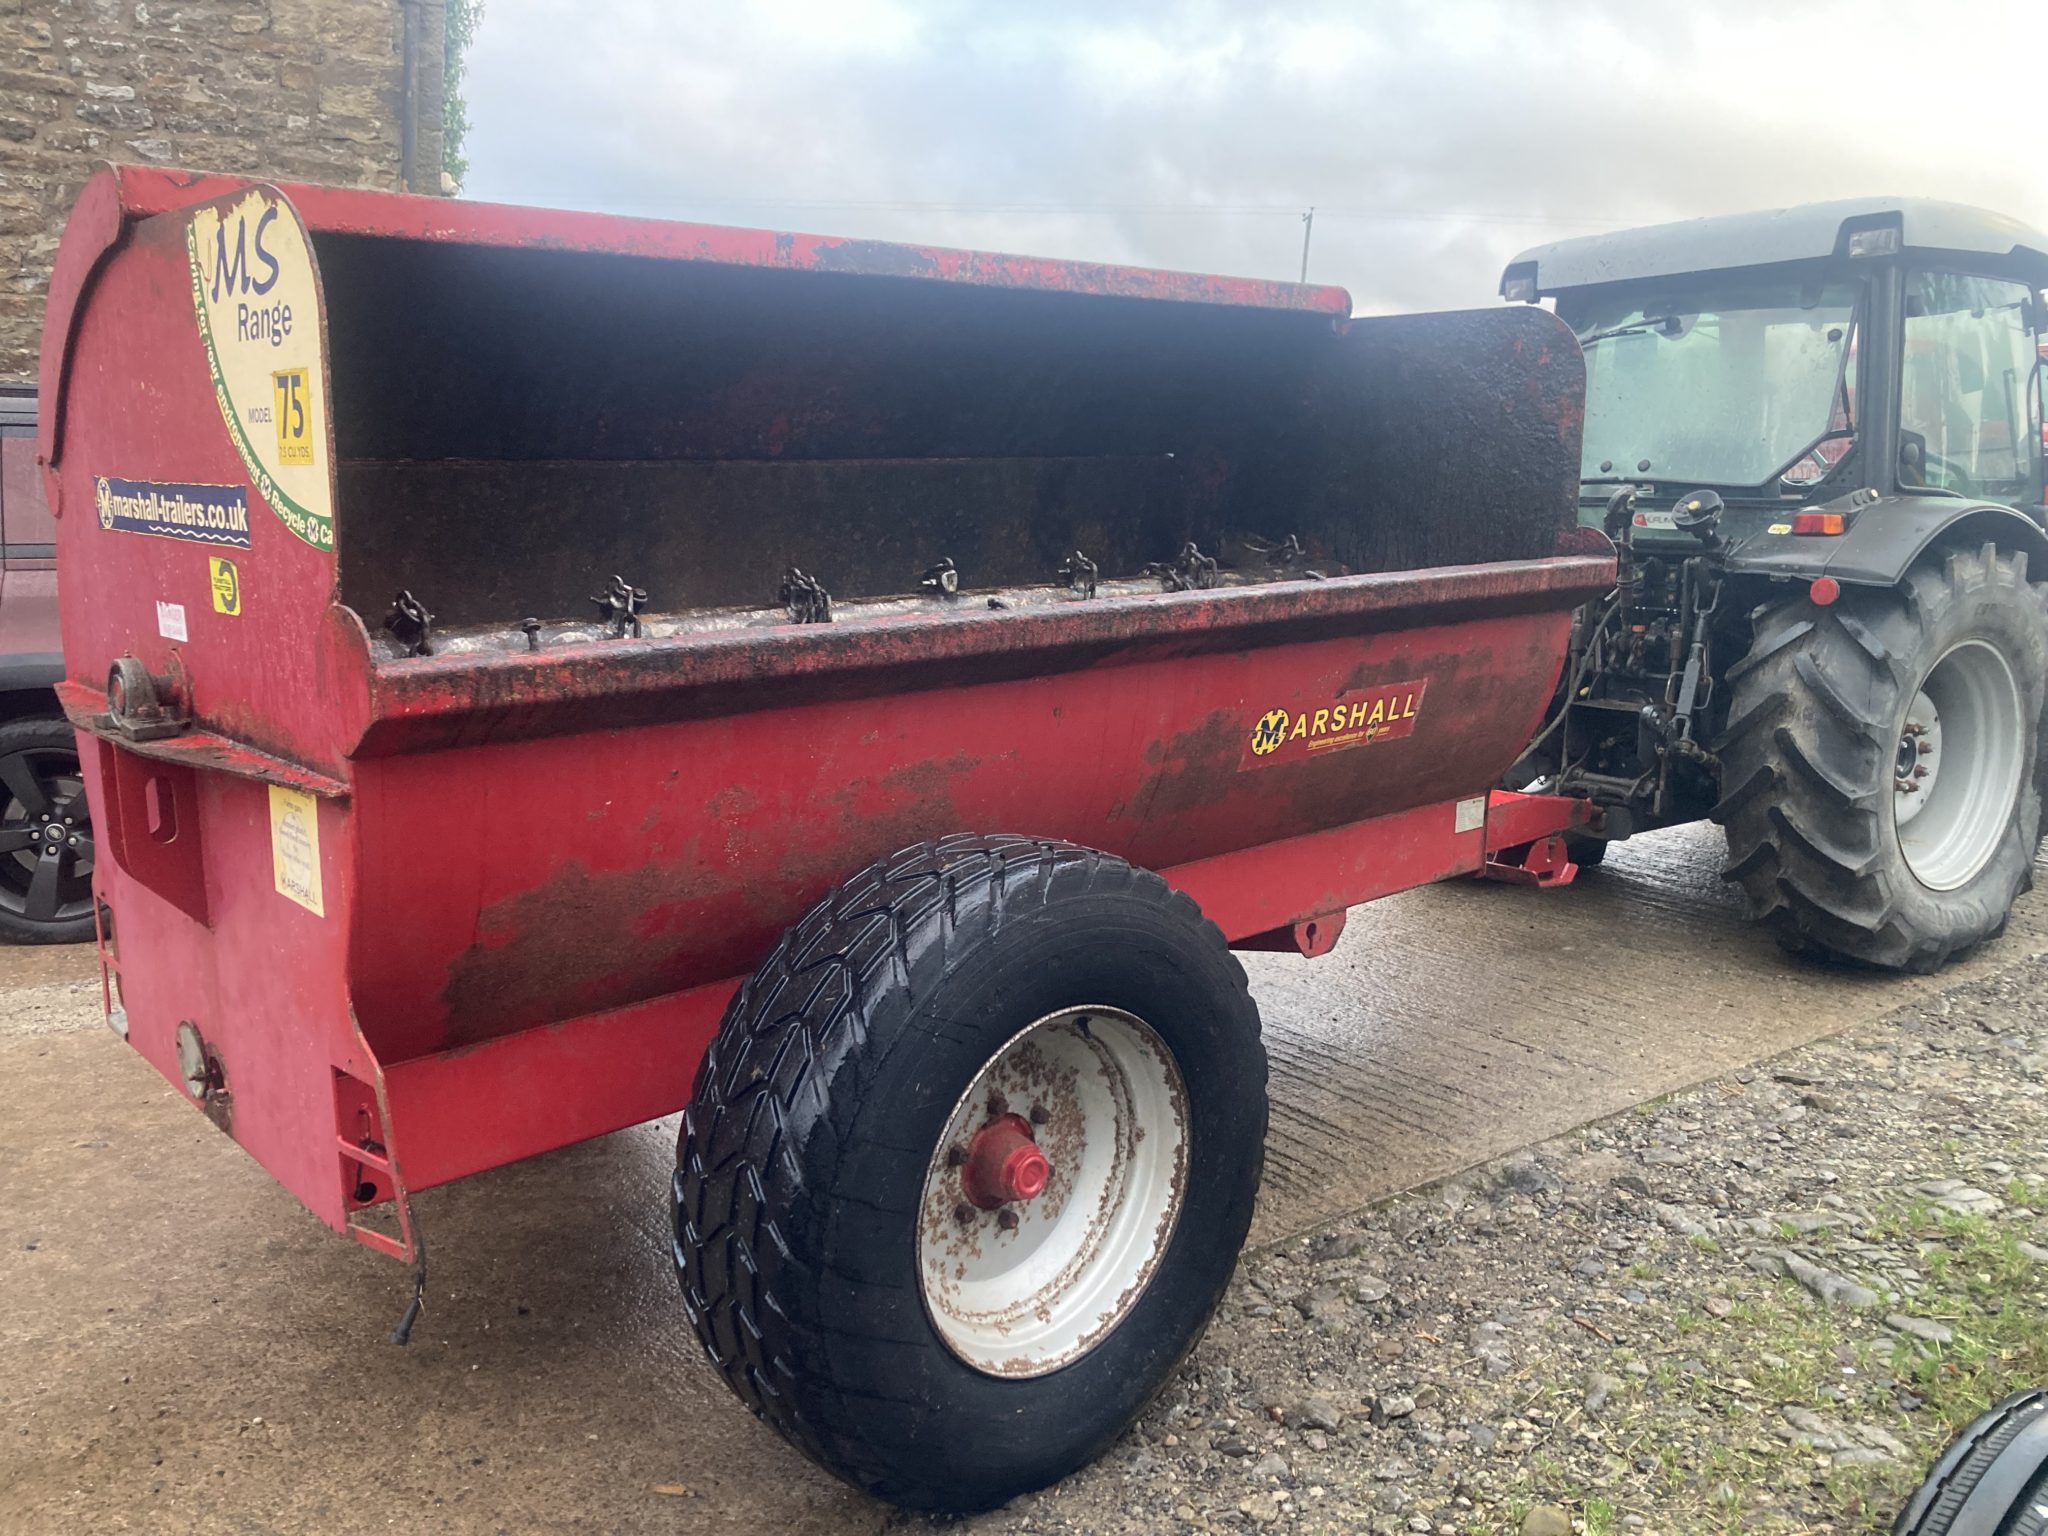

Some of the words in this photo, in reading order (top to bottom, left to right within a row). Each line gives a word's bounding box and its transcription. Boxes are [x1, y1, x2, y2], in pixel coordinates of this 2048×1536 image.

[212, 206, 280, 304] MS
[238, 300, 292, 346] Range
[248, 407, 272, 423] MODEL
[276, 374, 304, 439] 75
[217, 384, 262, 483] environment
[271, 490, 306, 534] Recycle
[112, 492, 248, 532] marshall-trailers.co.uk
[1251, 693, 1416, 756] MARSHALL
